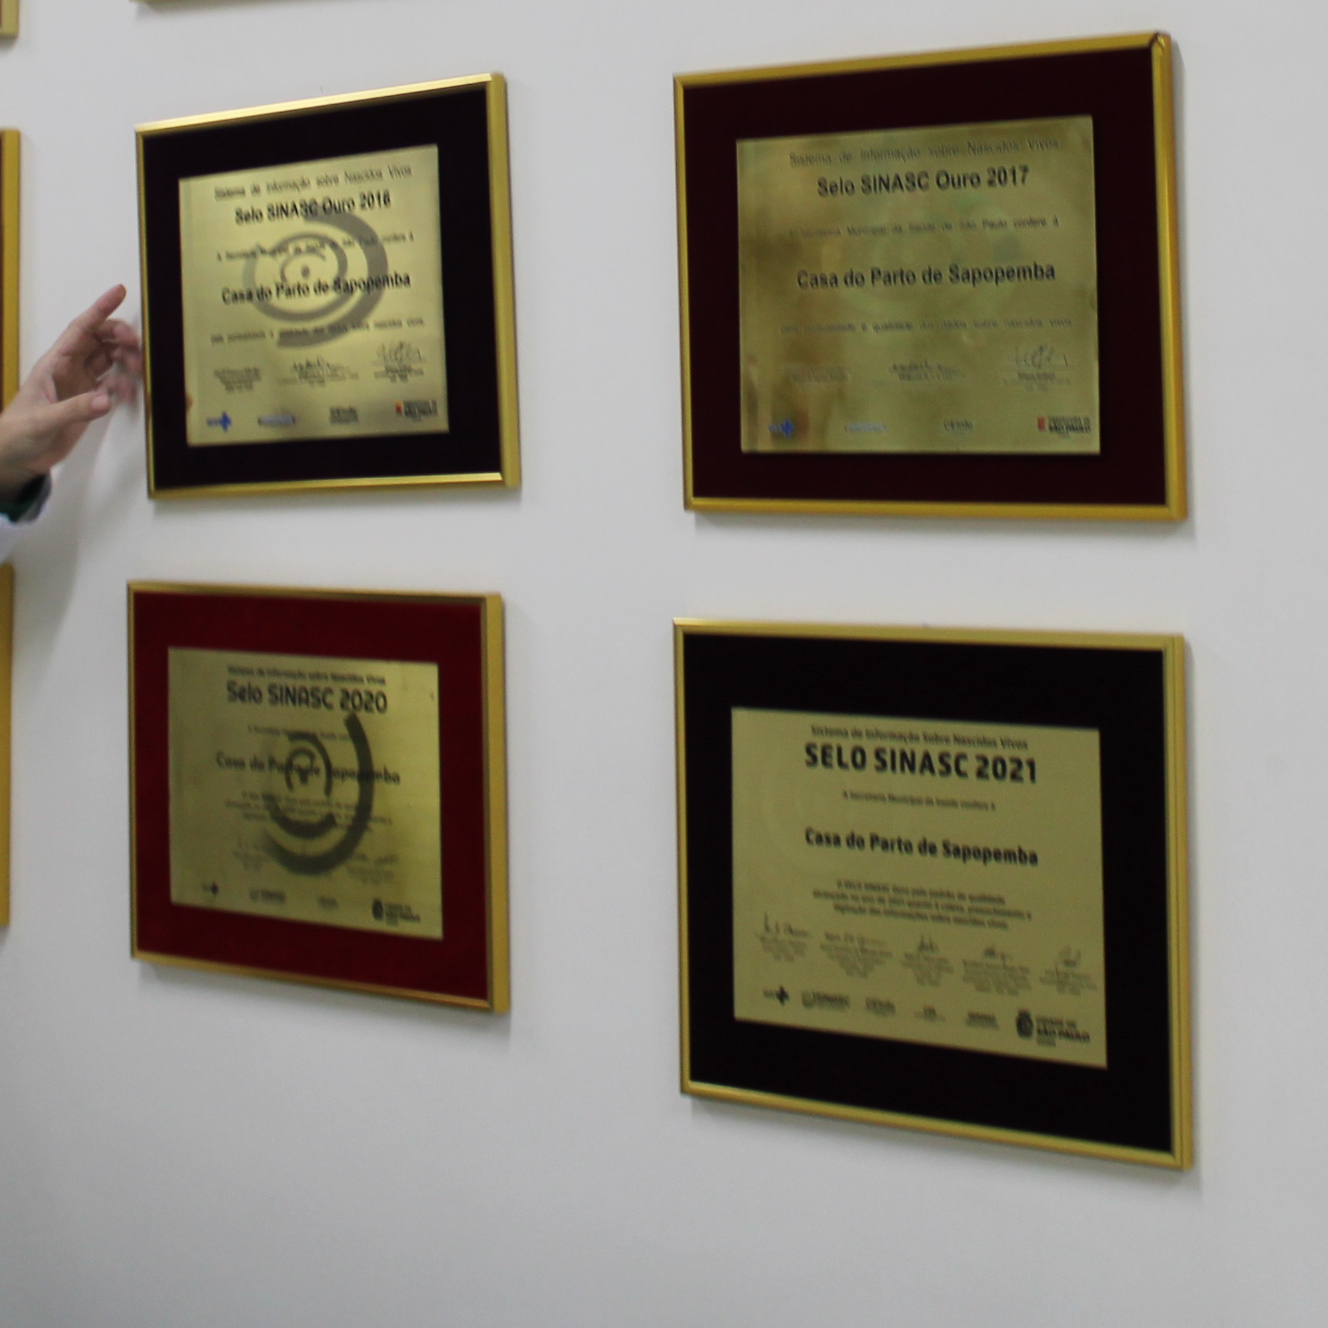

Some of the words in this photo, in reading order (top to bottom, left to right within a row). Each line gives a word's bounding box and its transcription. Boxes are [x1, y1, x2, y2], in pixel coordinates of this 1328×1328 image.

[816, 174, 854, 197] Selo
[860, 170, 930, 195] SINASC
[935, 167, 980, 191] Ouro
[987, 164, 1030, 188] 2017
[235, 204, 263, 226] Selo
[267, 198, 317, 222] SINASC
[322, 193, 355, 215] Ouro
[221, 283, 253, 306] Casa
[256, 281, 272, 302] do
[274, 278, 310, 300] Parto
[312, 275, 330, 297] de
[796, 267, 838, 292] Casa
[843, 266, 865, 290] do
[869, 264, 916, 289] Parto
[921, 263, 942, 288] de
[947, 259, 1055, 287] Sapopemba
[226, 680, 262, 704] Selo
[267, 683, 333, 710] SINASC
[338, 688, 387, 714] 2020
[804, 741, 867, 771] SELO
[874, 746, 969, 778] SINASC
[975, 753, 1037, 784] 2021
[805, 826, 841, 850] Casa
[845, 829, 865, 852] do
[869, 832, 912, 857] Parto
[917, 836, 937, 859] de
[941, 838, 1038, 869] Sapopemba
